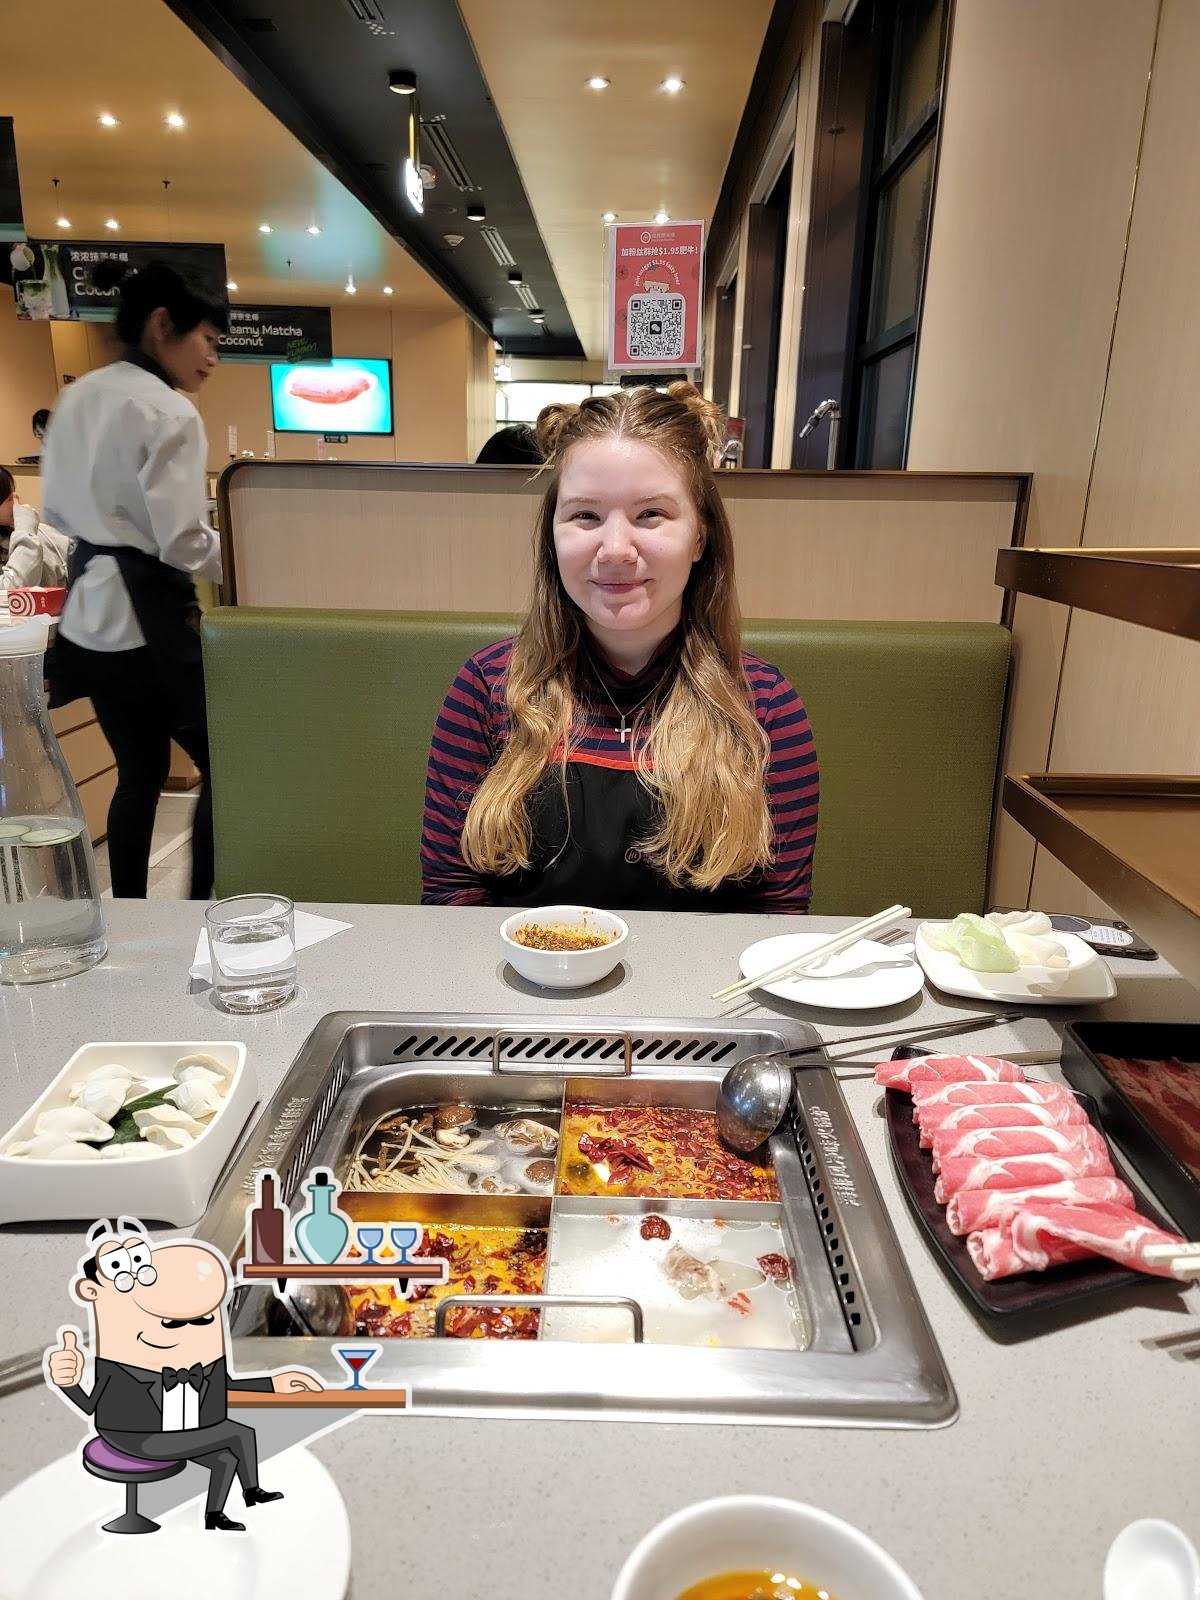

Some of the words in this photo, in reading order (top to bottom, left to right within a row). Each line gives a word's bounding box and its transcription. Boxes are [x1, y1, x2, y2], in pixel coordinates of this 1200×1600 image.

[229, 325, 259, 338] eamy
[262, 325, 303, 337] Matcha
[217, 334, 264, 347] Coconut
